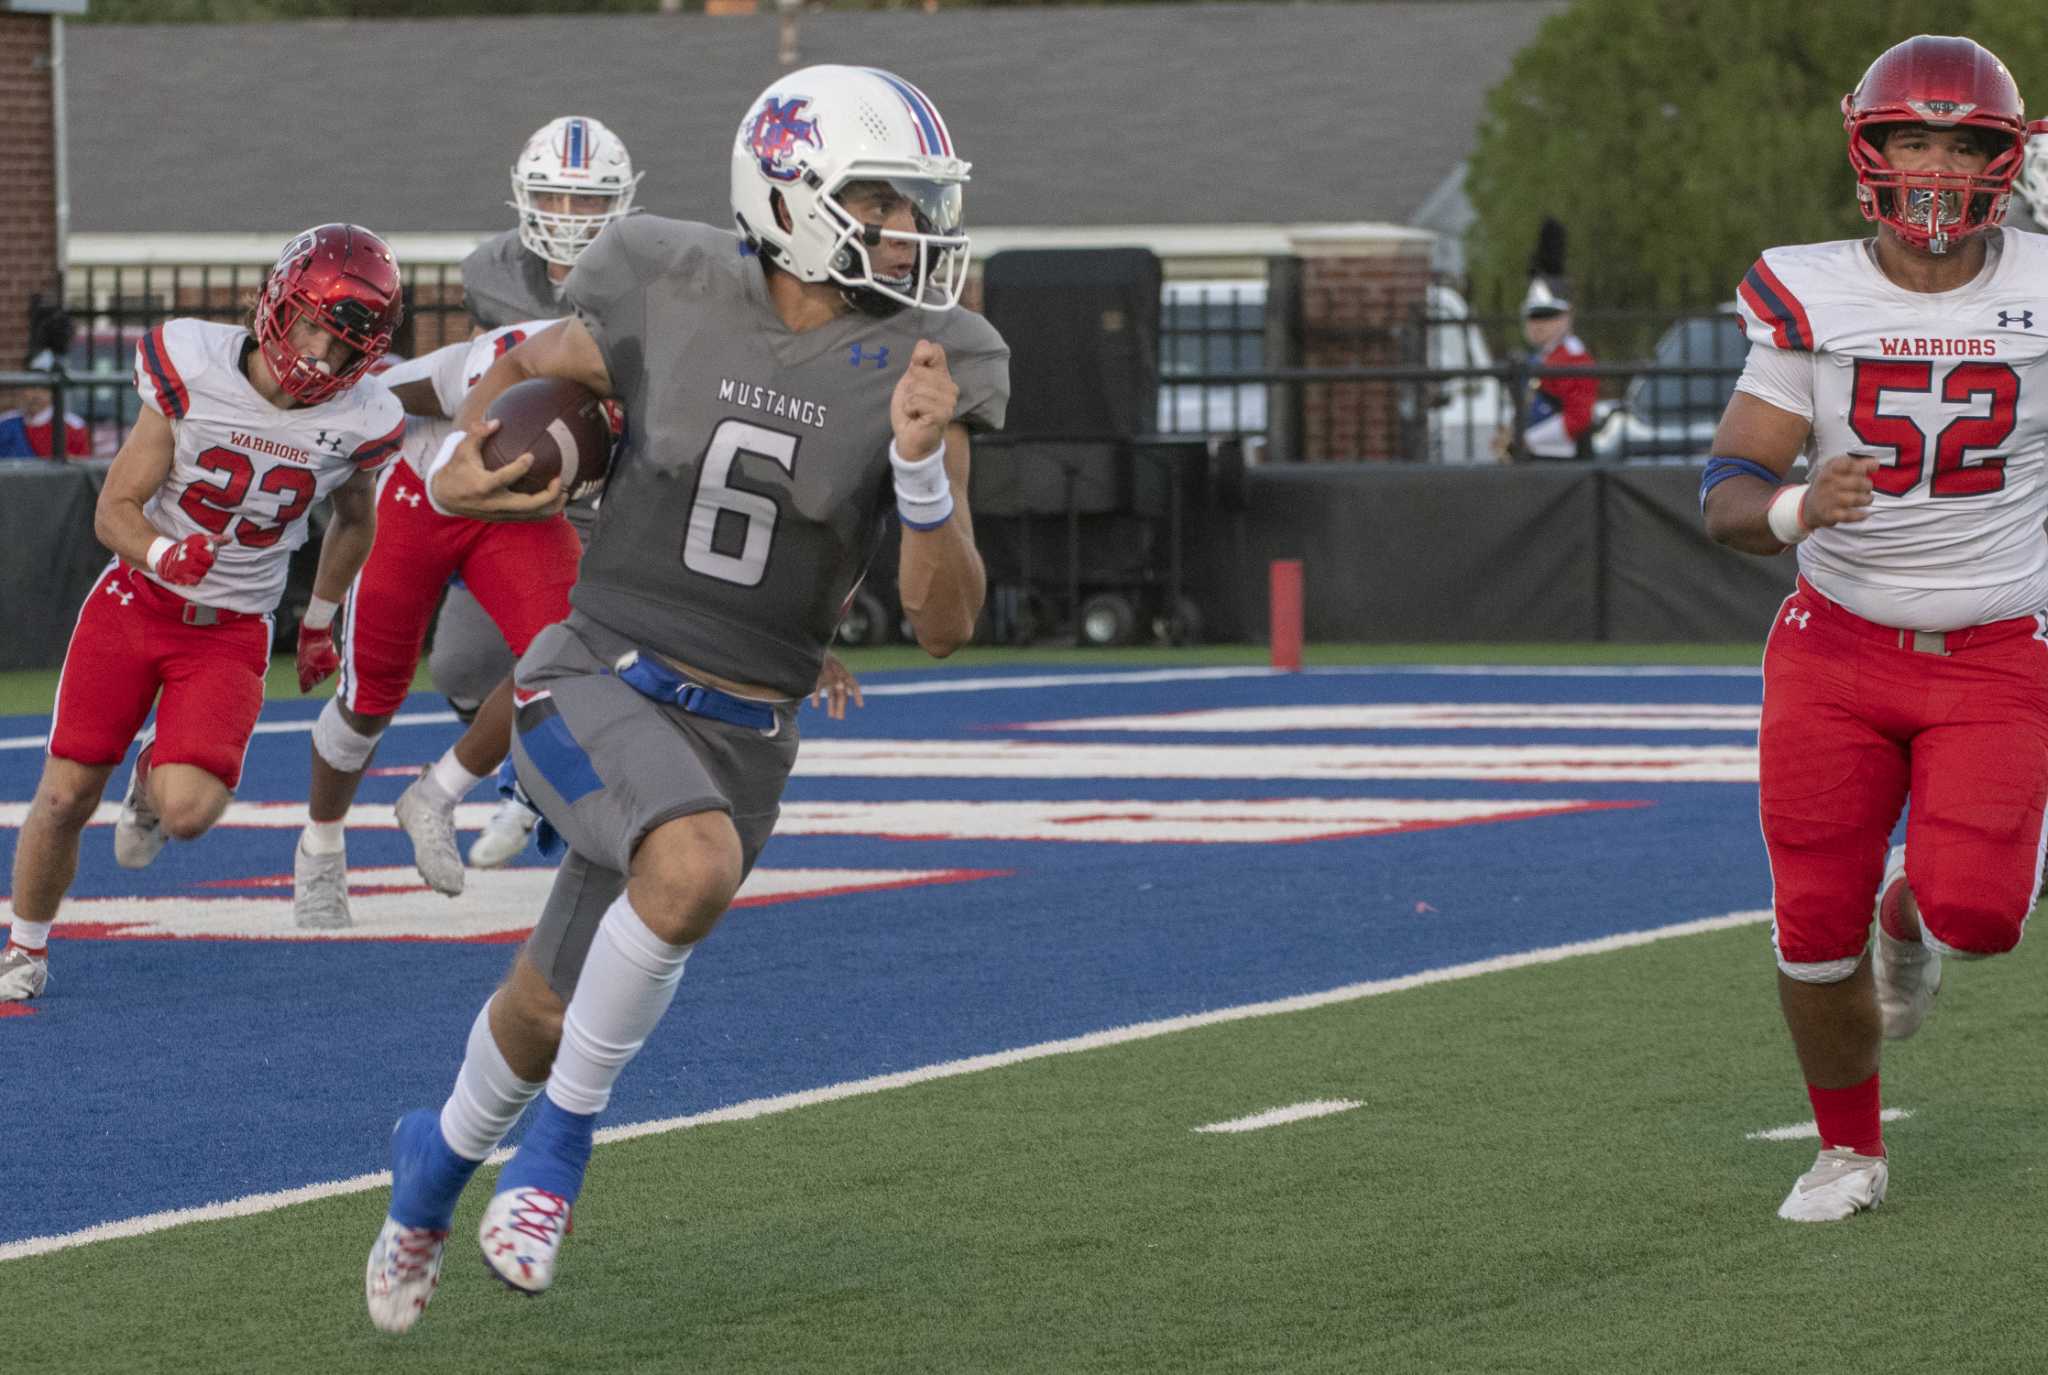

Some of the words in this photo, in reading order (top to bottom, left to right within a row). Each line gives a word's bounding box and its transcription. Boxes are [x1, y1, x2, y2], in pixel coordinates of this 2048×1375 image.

[1879, 337, 1997, 357] WARRIORS
[718, 378, 827, 428] MUSTANGS
[1848, 357, 2021, 499] 52
[230, 431, 310, 465] WARRIORS
[178, 445, 317, 549] 23
[683, 416, 802, 588] 6
